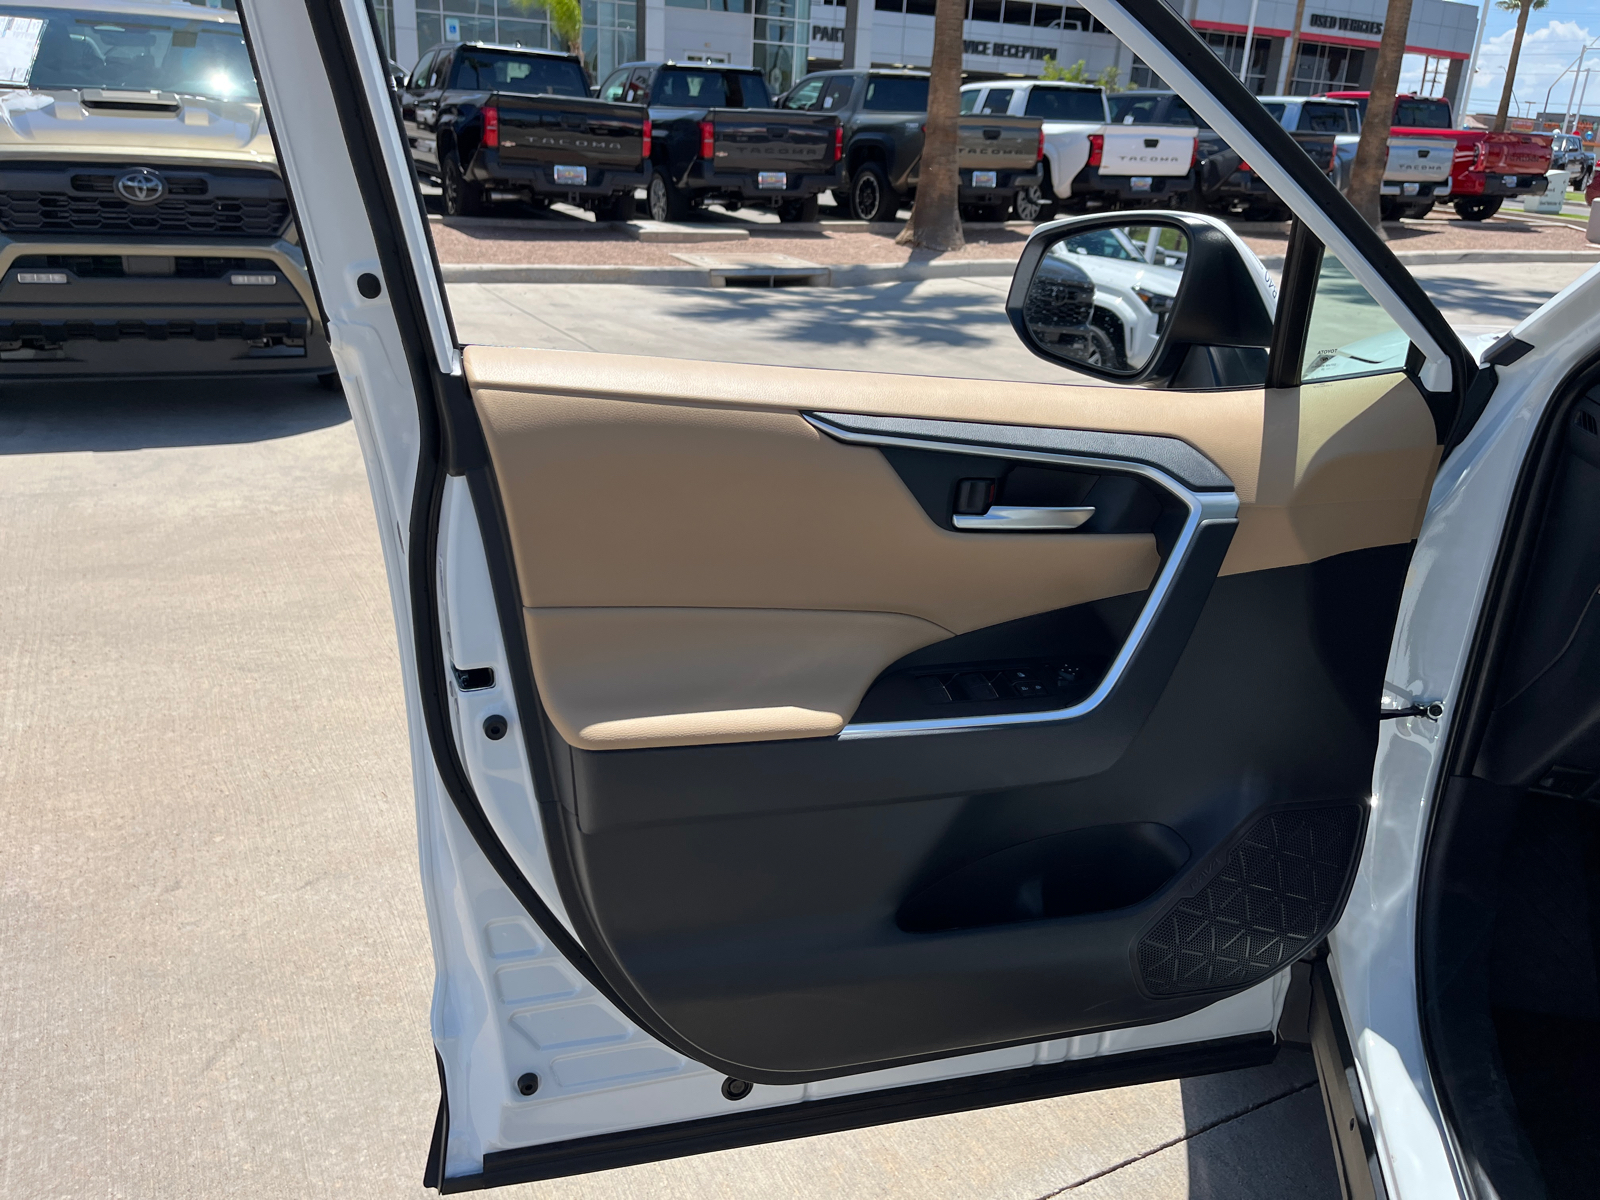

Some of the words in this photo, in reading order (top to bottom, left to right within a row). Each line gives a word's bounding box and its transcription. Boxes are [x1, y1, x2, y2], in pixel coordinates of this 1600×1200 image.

[812, 25, 845, 42] PART
[963, 40, 991, 56] VICE
[525, 135, 621, 149] TACOMA
[736, 146, 817, 156] TACOMA
[958, 147, 1025, 156] TACOMA
[1399, 163, 1442, 171] TACOMA
